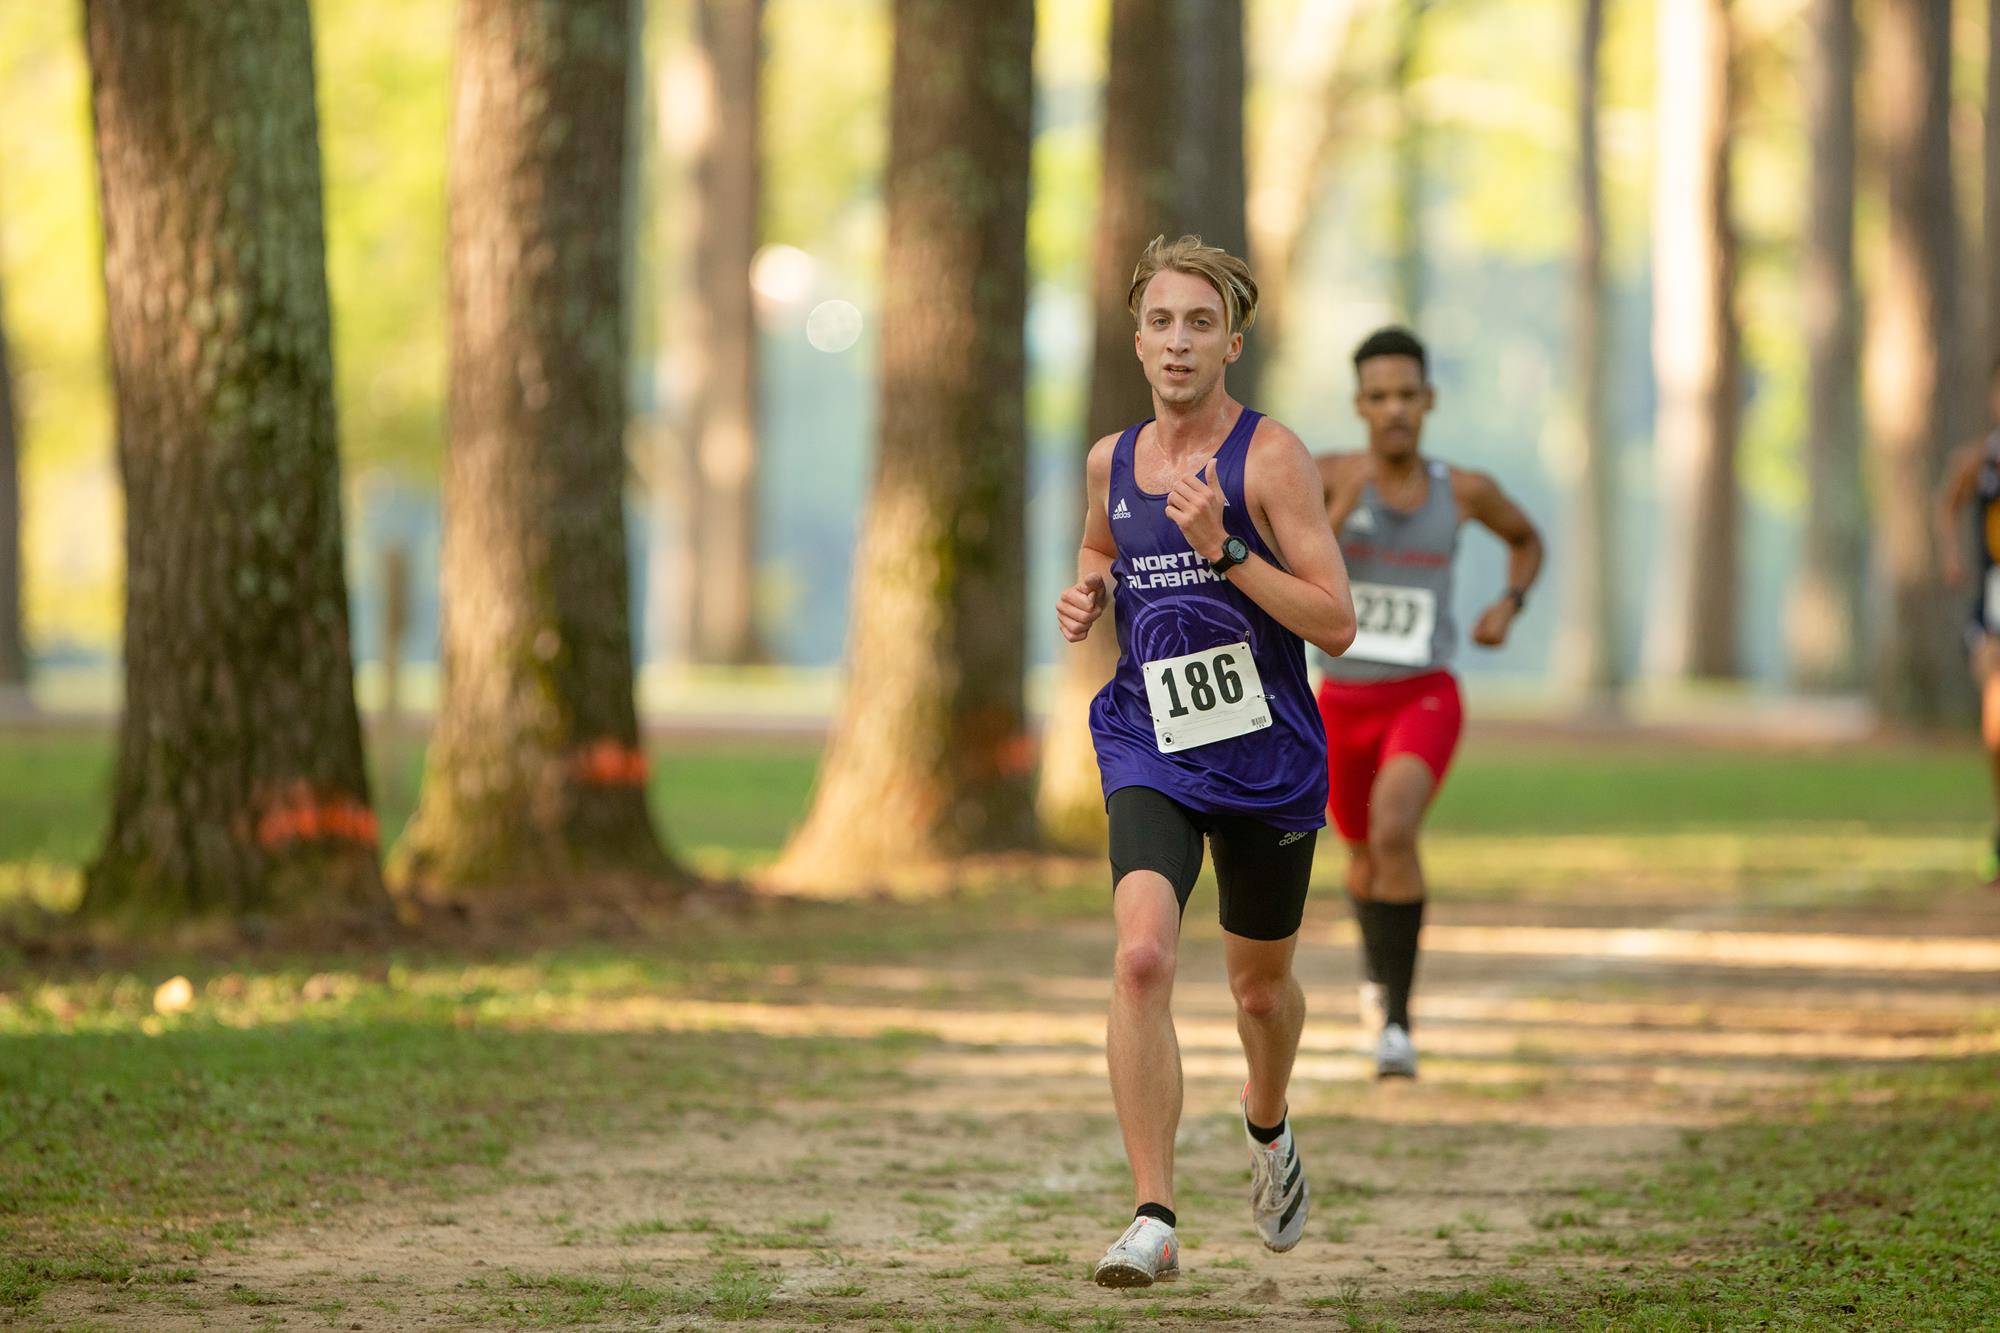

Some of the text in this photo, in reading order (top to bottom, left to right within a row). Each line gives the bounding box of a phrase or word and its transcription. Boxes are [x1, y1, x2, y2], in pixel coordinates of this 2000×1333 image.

[1112, 511, 1132, 520] adidas
[1131, 551, 1211, 572] NORTH
[1126, 568, 1227, 589] ALABAM
[1161, 653, 1244, 718] 186
